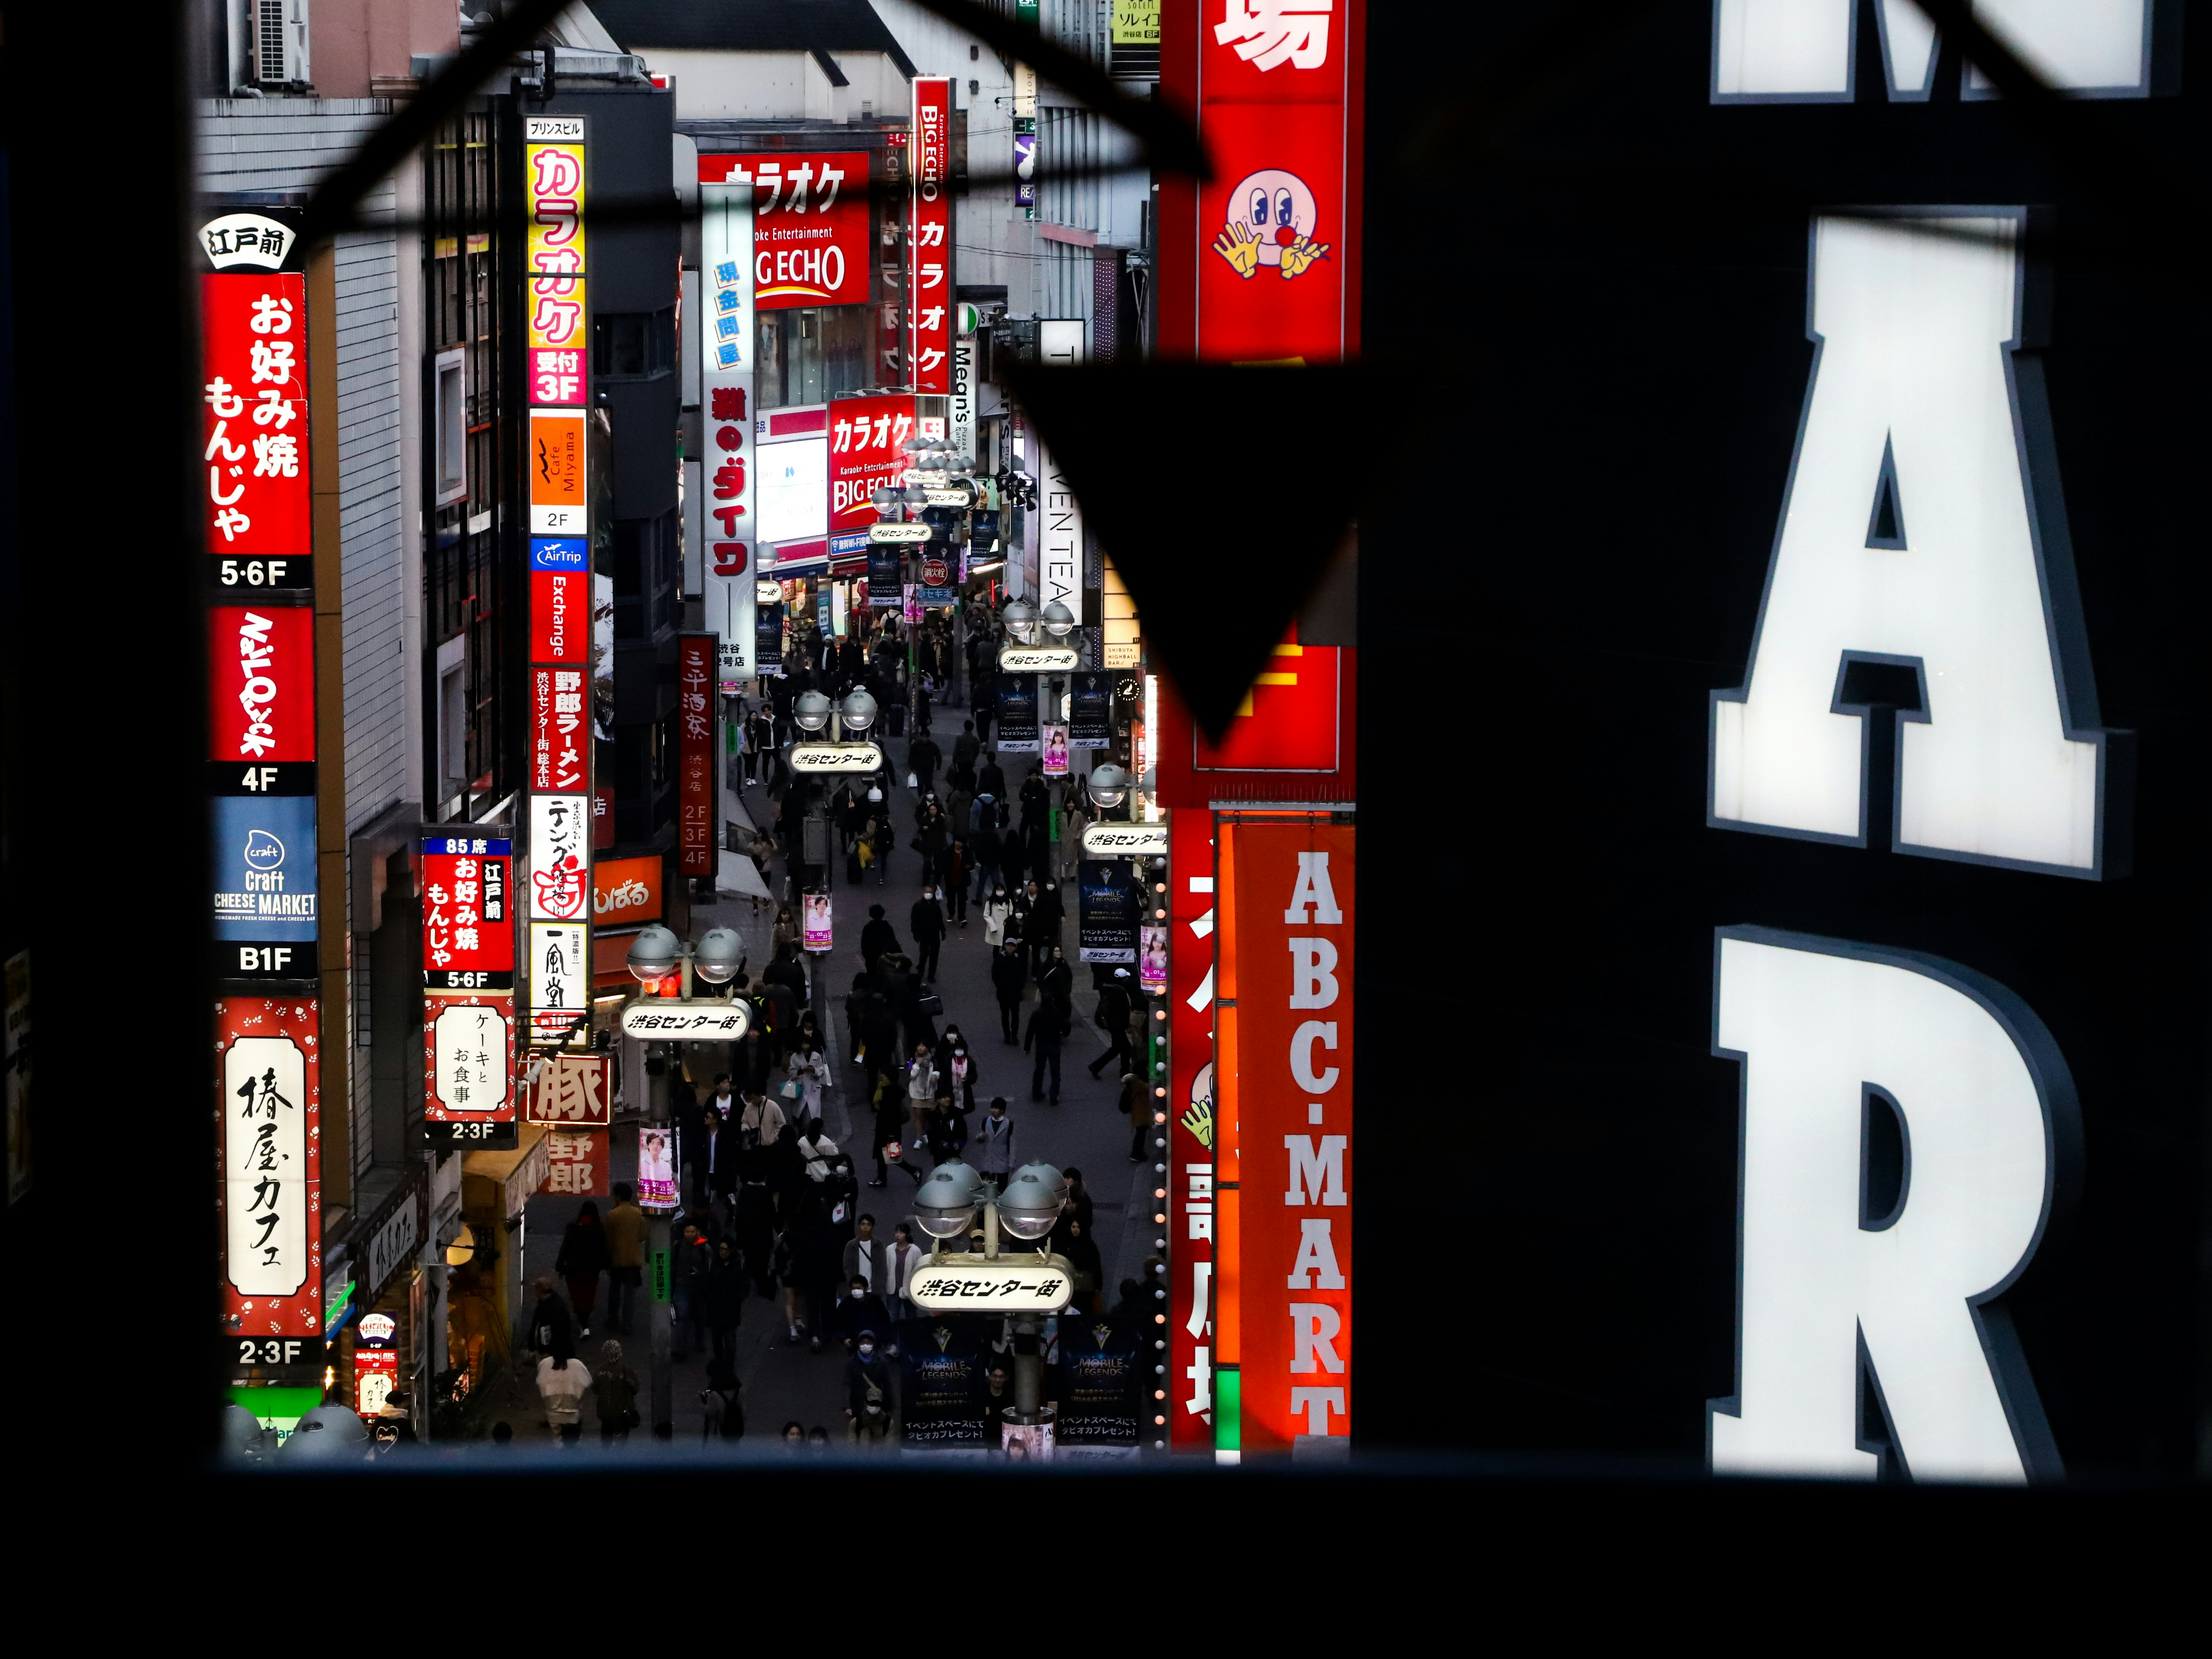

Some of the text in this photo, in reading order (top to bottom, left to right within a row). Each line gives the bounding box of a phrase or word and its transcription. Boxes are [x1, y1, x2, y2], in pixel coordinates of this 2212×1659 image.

[531, 122, 580, 135] プリンスビル
[922, 106, 938, 202] BIG ECHO
[207, 227, 284, 257] 江戸前
[772, 226, 833, 240] Entertainment
[533, 148, 581, 345] カラオケ
[919, 221, 945, 373] カラオケ
[715, 259, 743, 366] 現金問屋
[537, 351, 579, 373] 受付
[250, 293, 299, 478] お好み焼
[537, 376, 579, 402] 3F
[955, 347, 971, 423] Mean's
[833, 413, 912, 454] カラオケ
[204, 376, 250, 542] もんじゃ
[550, 446, 560, 476] Cafe
[564, 431, 575, 492] Miyama
[840, 465, 863, 475] Karaoke
[834, 479, 864, 513] BIG
[548, 513, 568, 526] 2F
[545, 550, 582, 564] AirTrip
[924, 568, 945, 578] 消火栓
[1049, 541, 1073, 602] TEA
[926, 589, 952, 598] セキネ
[550, 576, 566, 656] Exchange
[1004, 655, 1073, 665] 渋谷センター街
[555, 671, 582, 788] 野郎ラーメン
[795, 754, 877, 765] 渋谷センター街
[242, 767, 278, 792] 4F
[689, 755, 703, 792] 渋谷店
[685, 805, 706, 818] 2F
[685, 828, 706, 841] 3F
[685, 851, 706, 865] 4F
[245, 870, 284, 891] Craft
[484, 864, 501, 919] 江戸前
[215, 894, 316, 916] CHEESE MARKET
[455, 857, 479, 951] お好み焼
[427, 883, 451, 967] もんじゃ
[240, 948, 292, 971] B1F
[546, 930, 572, 1007] 一風堂
[627, 1015, 741, 1030] 渋谷センター街
[476, 1013, 489, 1083] ケーキと
[453, 1048, 471, 1103] お食事
[536, 1057, 603, 1121] 豚
[236, 1067, 293, 1267] 椿屋カフェ
[548, 1132, 594, 1195] 野郎
[917, 1279, 1063, 1298] 渋谷センター街
[922, 1361, 967, 1371] MOBILE
[922, 1370, 967, 1379] LEGENDS
[1078, 1358, 1124, 1368] MOBILE
[1079, 1368, 1123, 1376] LEGENDS
[905, 1420, 984, 1430] イベントスペースにて
[1059, 1417, 1137, 1427] イベントスペースにて
[1062, 1427, 1136, 1437] タピオカプレゼント!
[908, 1430, 983, 1440] タピオカプレゼント!
